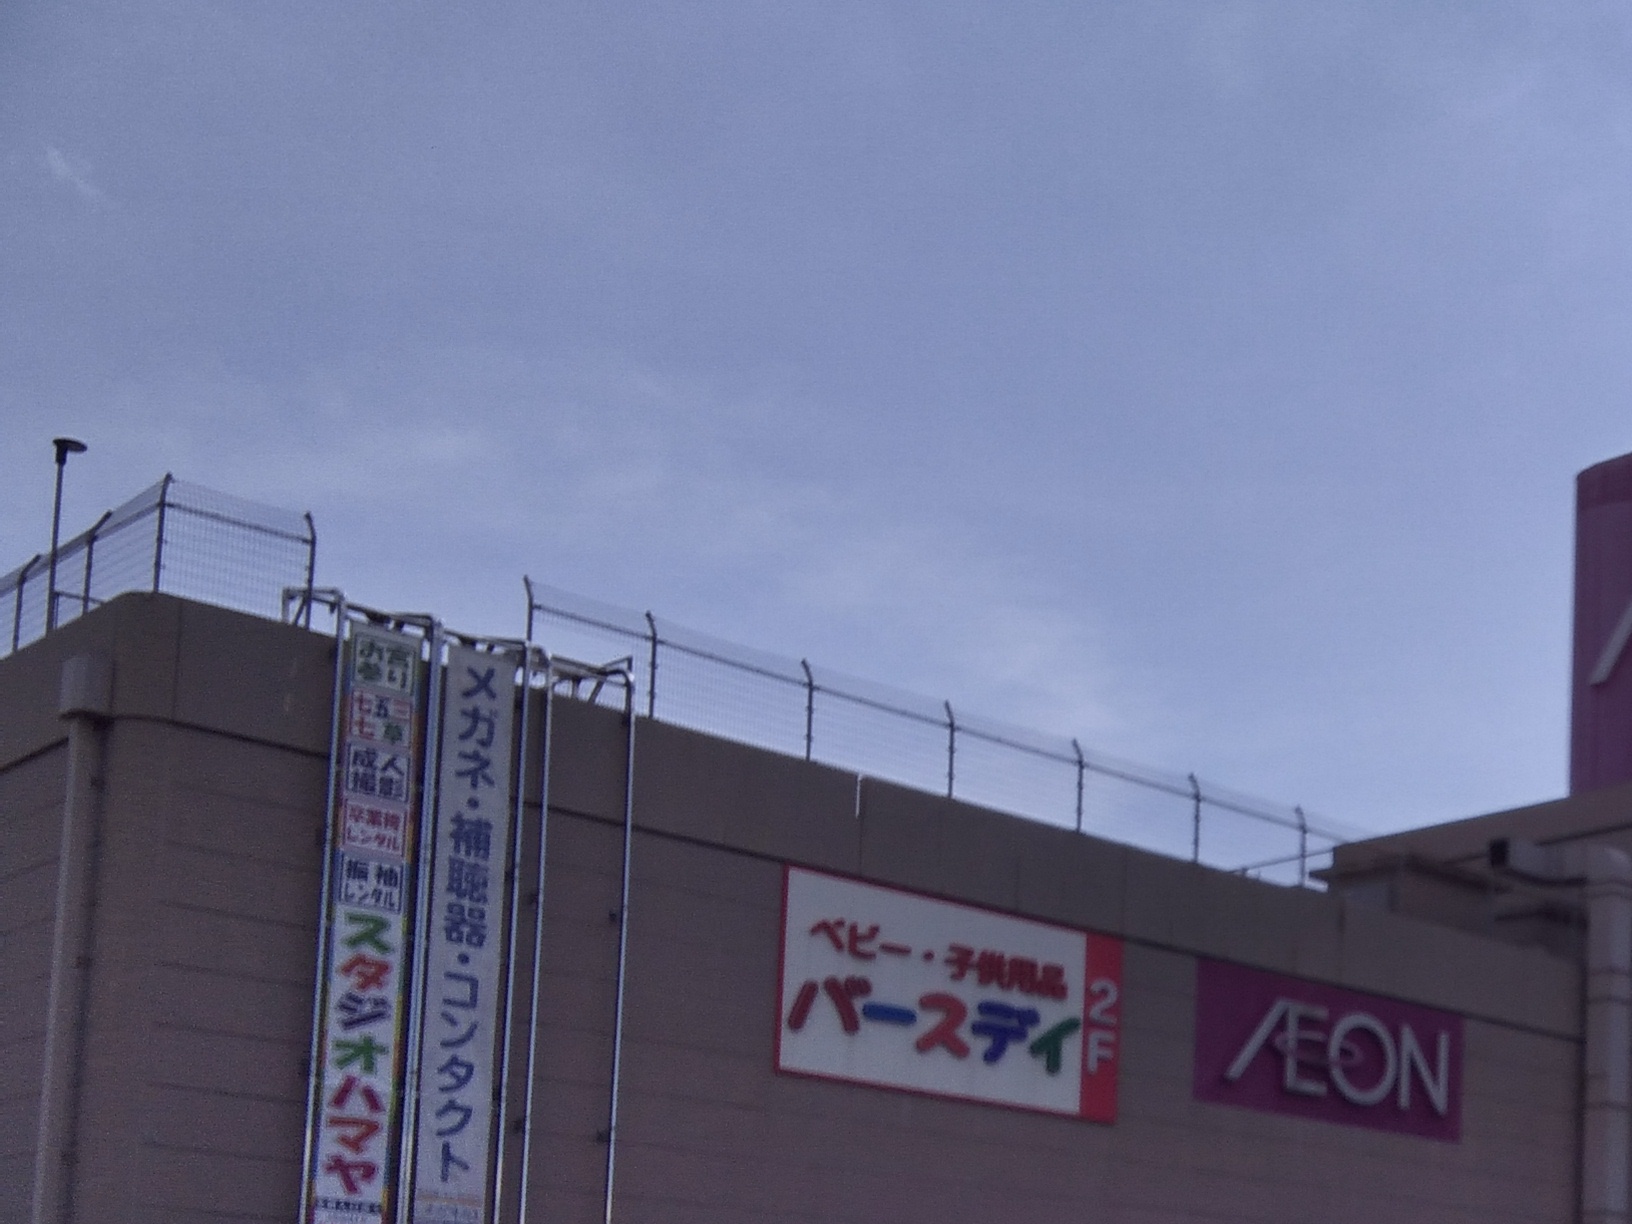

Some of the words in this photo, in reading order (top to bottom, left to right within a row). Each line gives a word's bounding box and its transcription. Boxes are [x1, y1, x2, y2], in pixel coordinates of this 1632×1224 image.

[809, 916, 1069, 1003] ベビー・子供用品
[324, 911, 394, 1196] スタジオハマヤ
[787, 975, 1081, 1077] バースデイ
